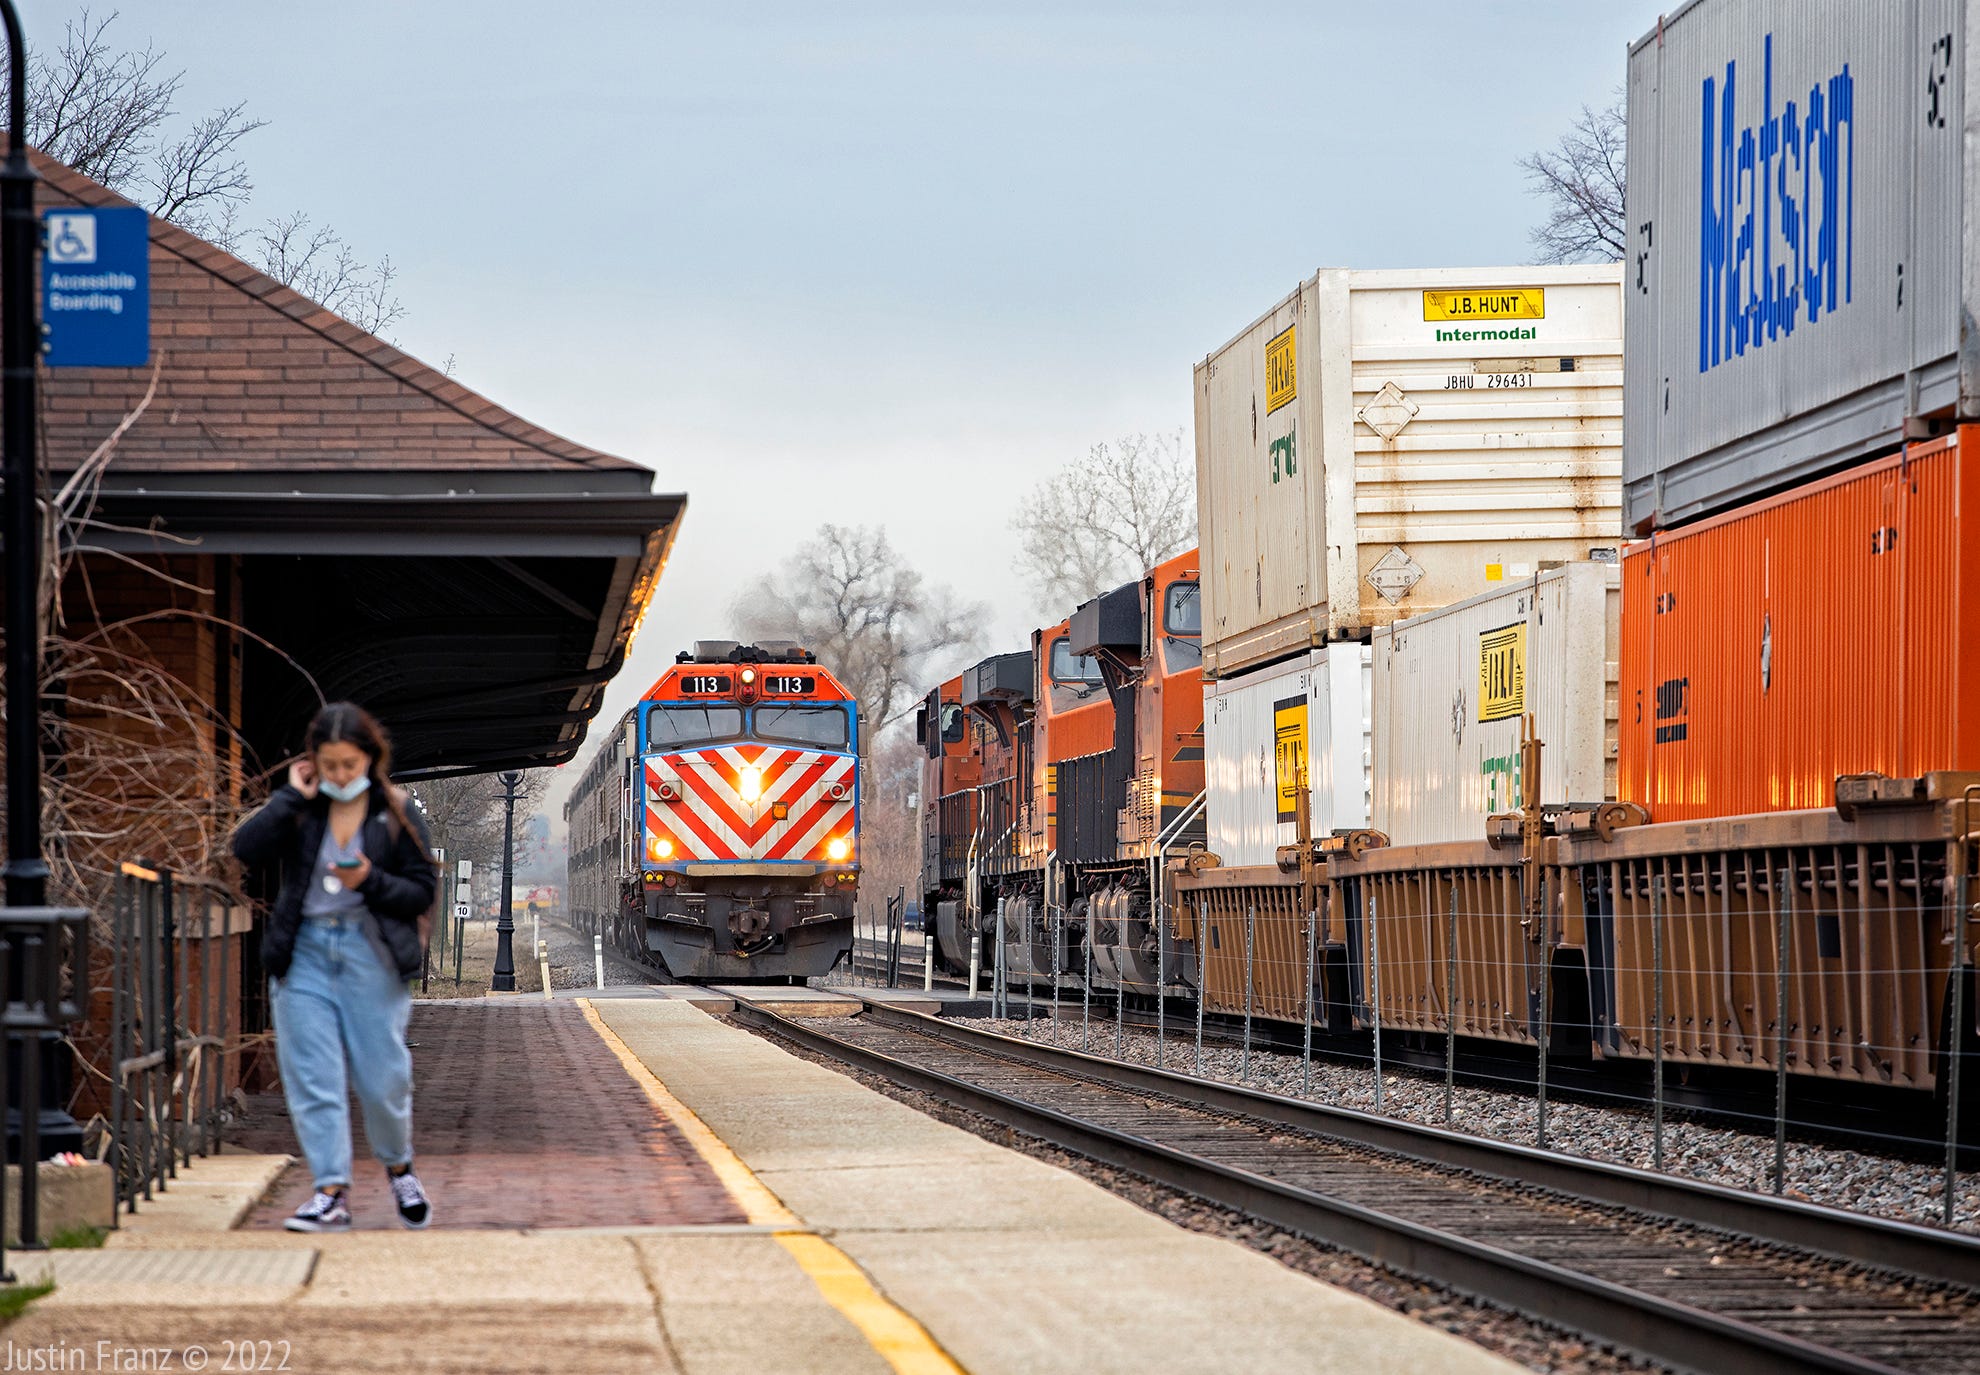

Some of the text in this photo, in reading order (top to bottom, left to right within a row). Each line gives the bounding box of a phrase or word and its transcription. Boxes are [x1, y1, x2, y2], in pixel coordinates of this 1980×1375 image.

[1700, 32, 1854, 374] Matson
[50, 272, 136, 290] Accessible
[50, 292, 123, 314] Boarding
[1449, 296, 1519, 314] J.B. HUNT
[1435, 326, 1537, 342] Intermodal
[1444, 373, 1533, 390] JBHU 296431
[693, 676, 718, 693] 113
[778, 676, 802, 693] 113
[457, 906, 468, 916] 10
